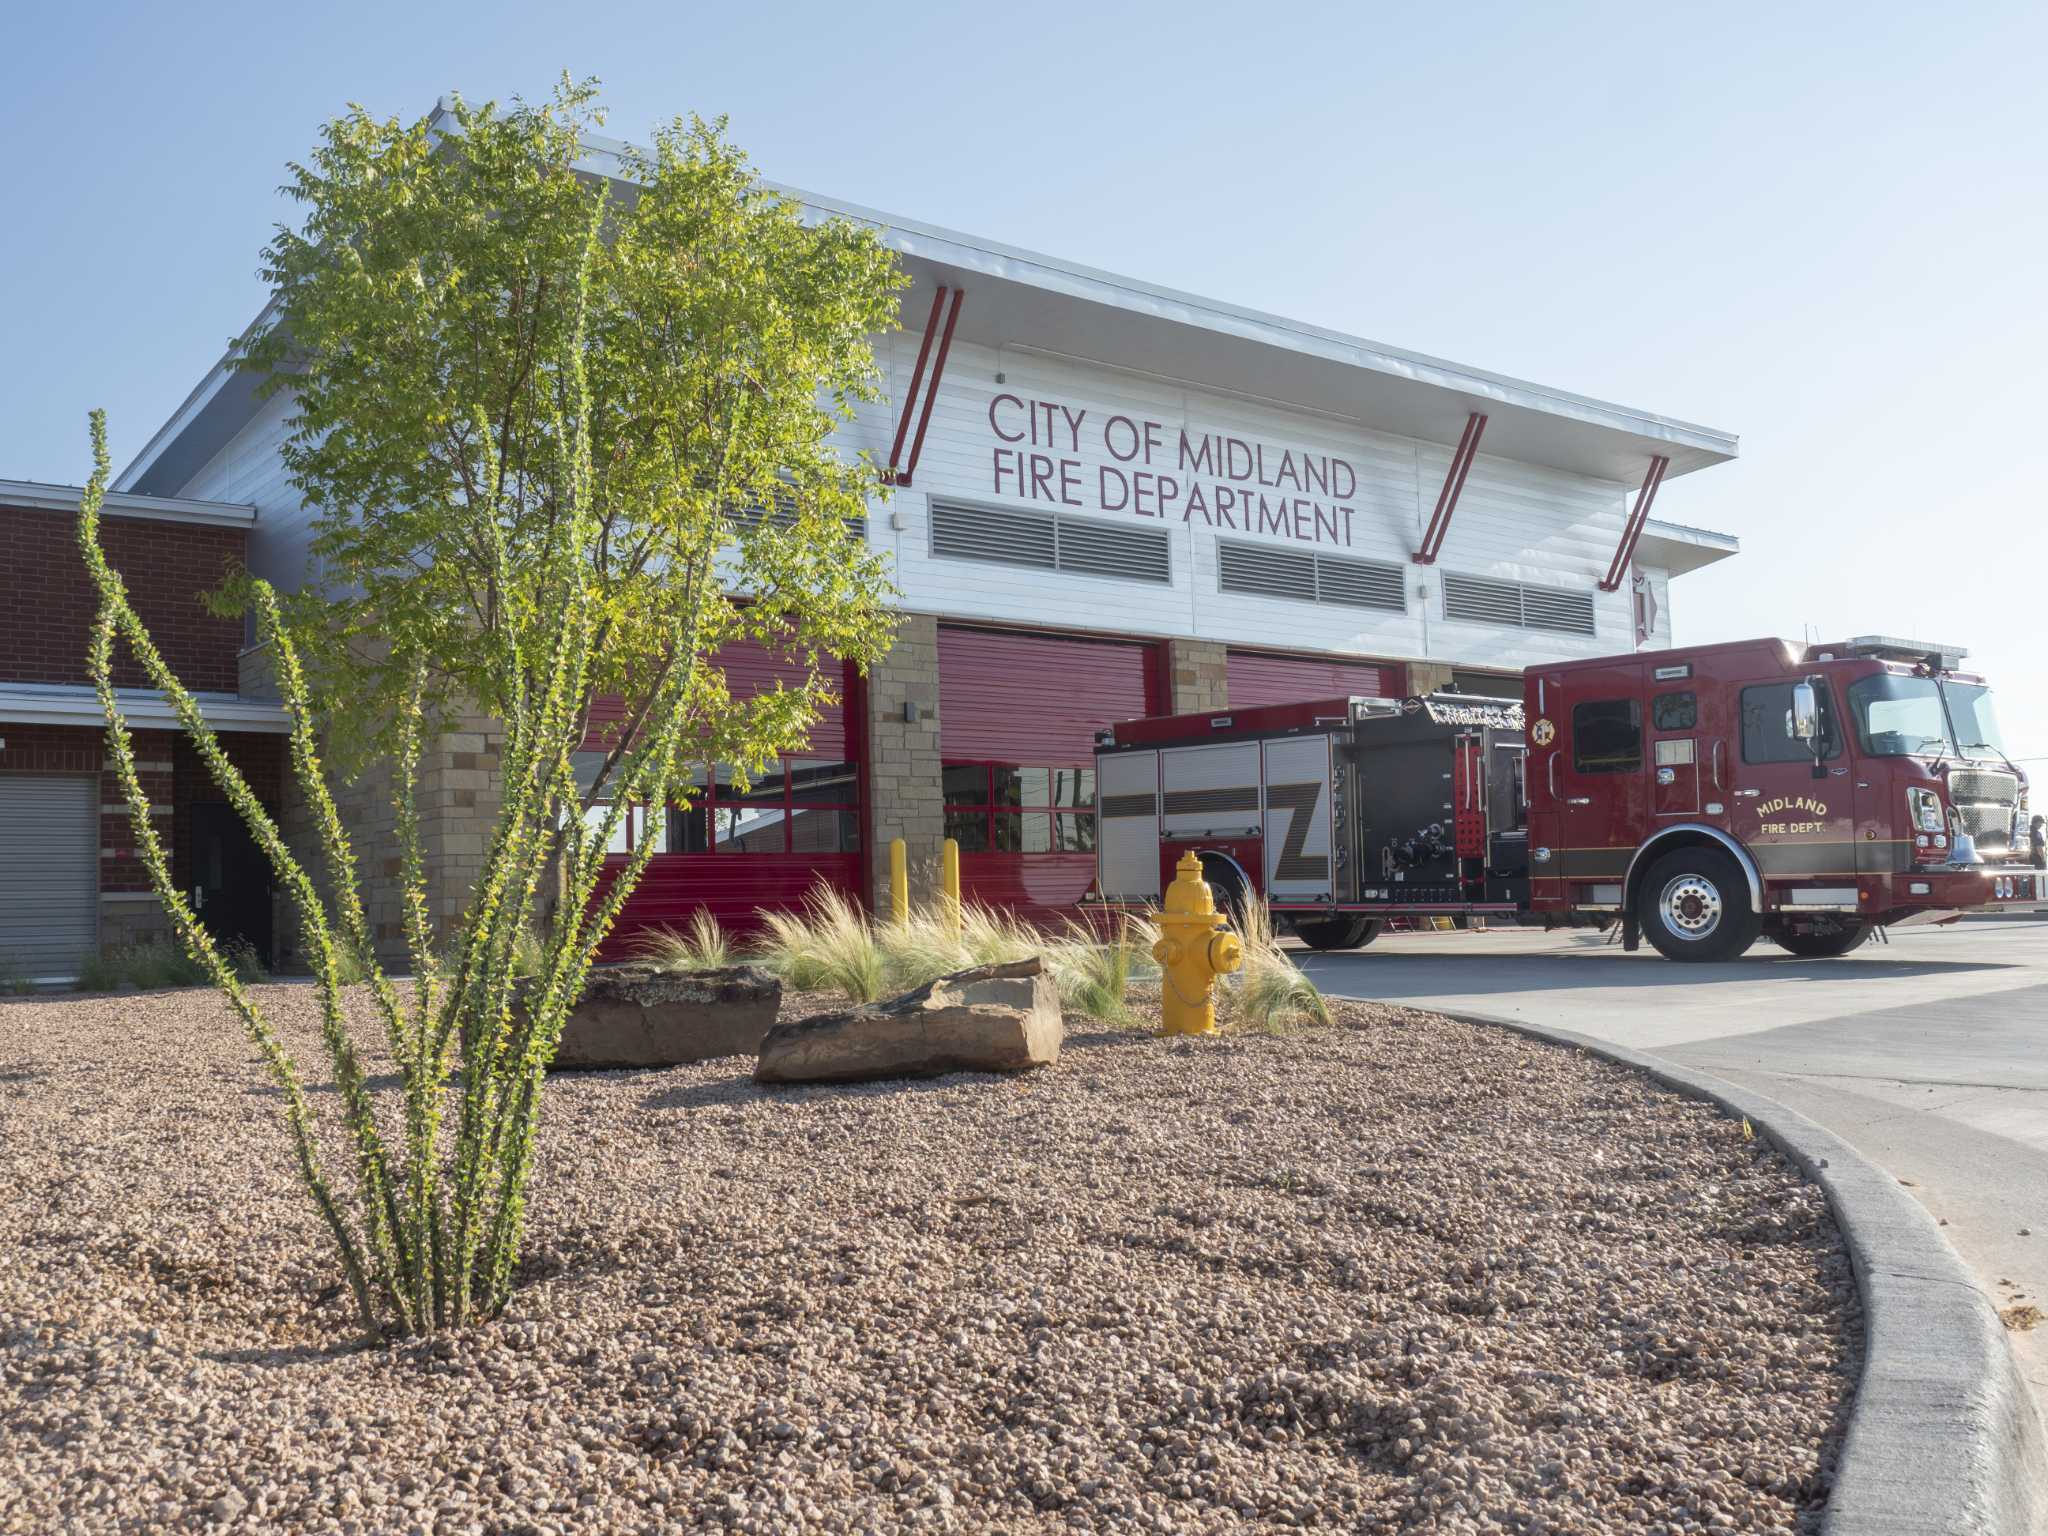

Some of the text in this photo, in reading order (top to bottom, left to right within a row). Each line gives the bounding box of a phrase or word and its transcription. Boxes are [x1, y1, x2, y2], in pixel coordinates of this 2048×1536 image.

[989, 394, 1356, 500] CITY OF MIDLAND
[994, 447, 1355, 547] FIRE DEPARTMENT
[1756, 796, 1828, 818] MIDLAND
[1761, 822, 1826, 834] FIRE DEPT.
